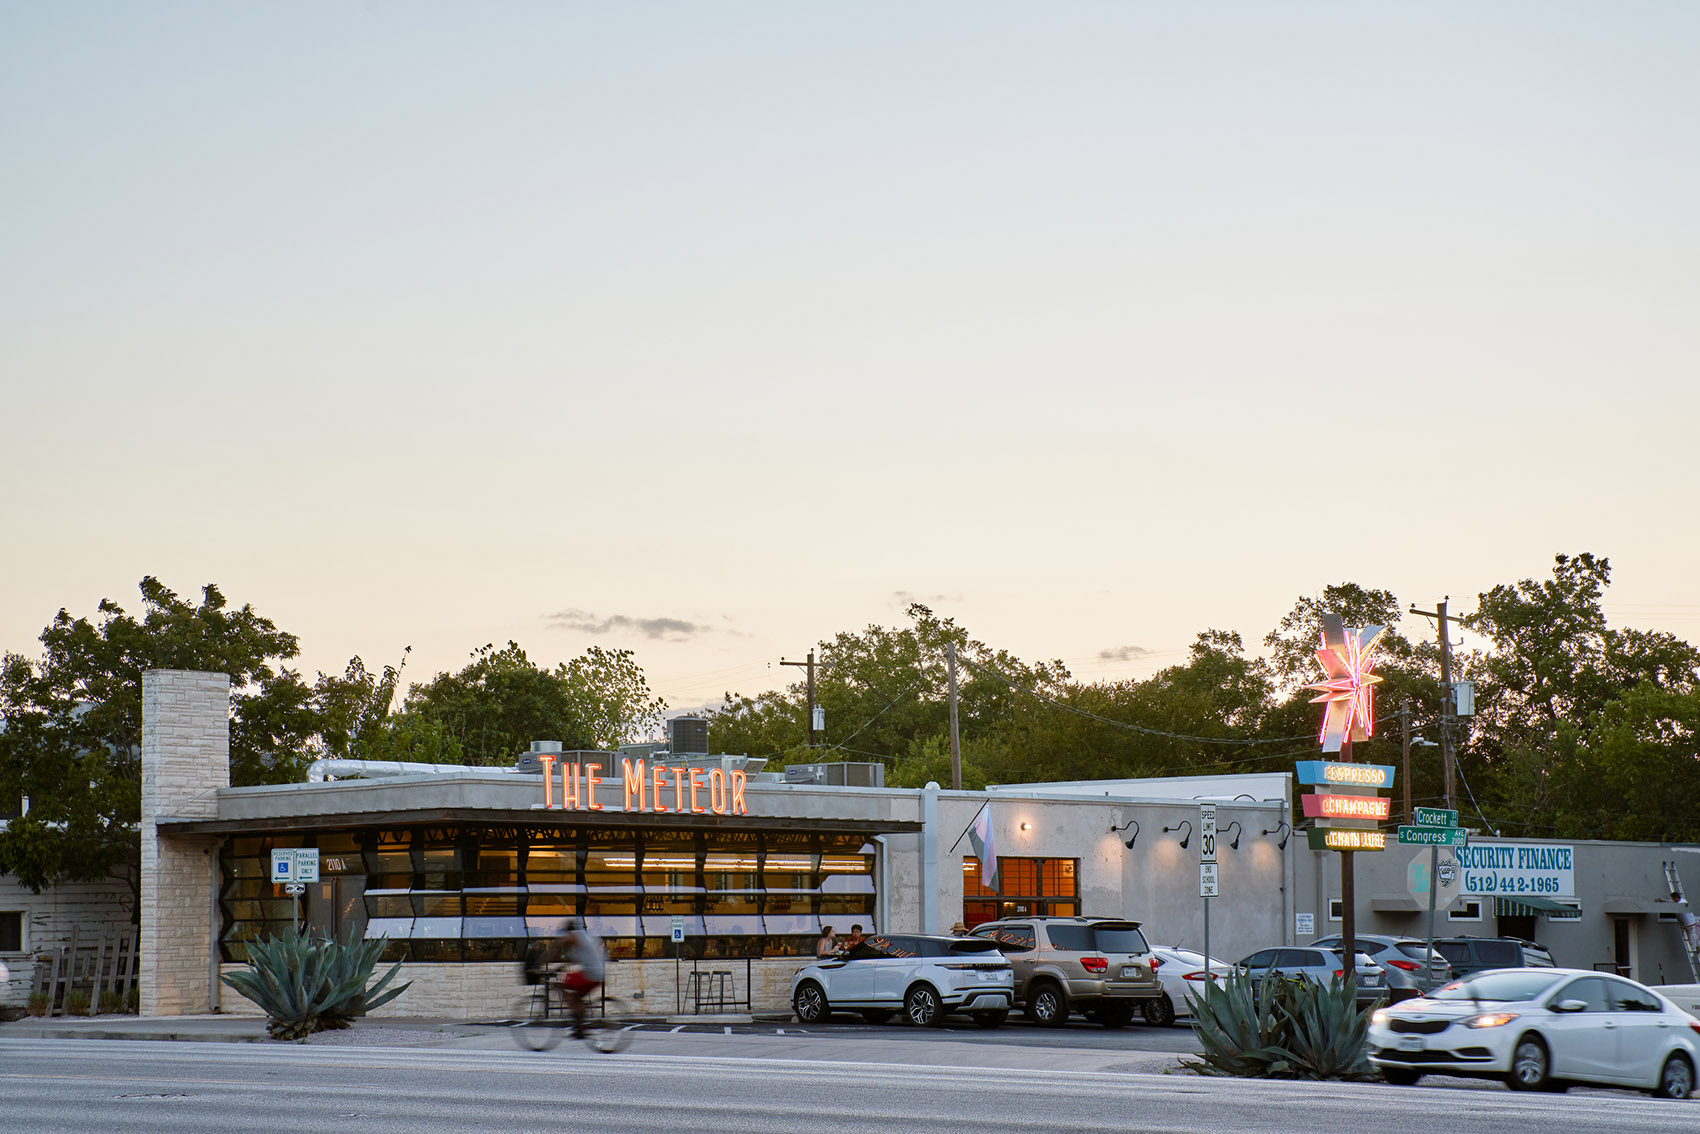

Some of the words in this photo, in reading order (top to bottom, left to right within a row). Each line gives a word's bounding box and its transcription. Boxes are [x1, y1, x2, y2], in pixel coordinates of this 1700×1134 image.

[1327, 766, 1386, 784] ESPRESSO
[539, 755, 603, 810] THE
[622, 758, 747, 814] METEOR
[1327, 797, 1387, 816] CHAMPAGNE
[1201, 810, 1215, 820] SPEED
[1418, 810, 1447, 825] Crockett
[1202, 822, 1214, 832] LIMIT
[1329, 831, 1360, 848] CHAIN
[1362, 832, 1386, 849] LUBE
[1400, 831, 1405, 839] S
[1406, 829, 1447, 844] Congress
[1454, 829, 1464, 837] AVE
[1451, 837, 1464, 845] 2100
[1202, 834, 1215, 855] 30
[1455, 846, 1514, 869] SECURITY
[1518, 847, 1571, 870] FINANCE
[1204, 865, 1212, 874] END
[1202, 875, 1215, 884] SCHOOL
[1465, 870, 1497, 892] (512)
[1203, 885, 1214, 894] ZONE
